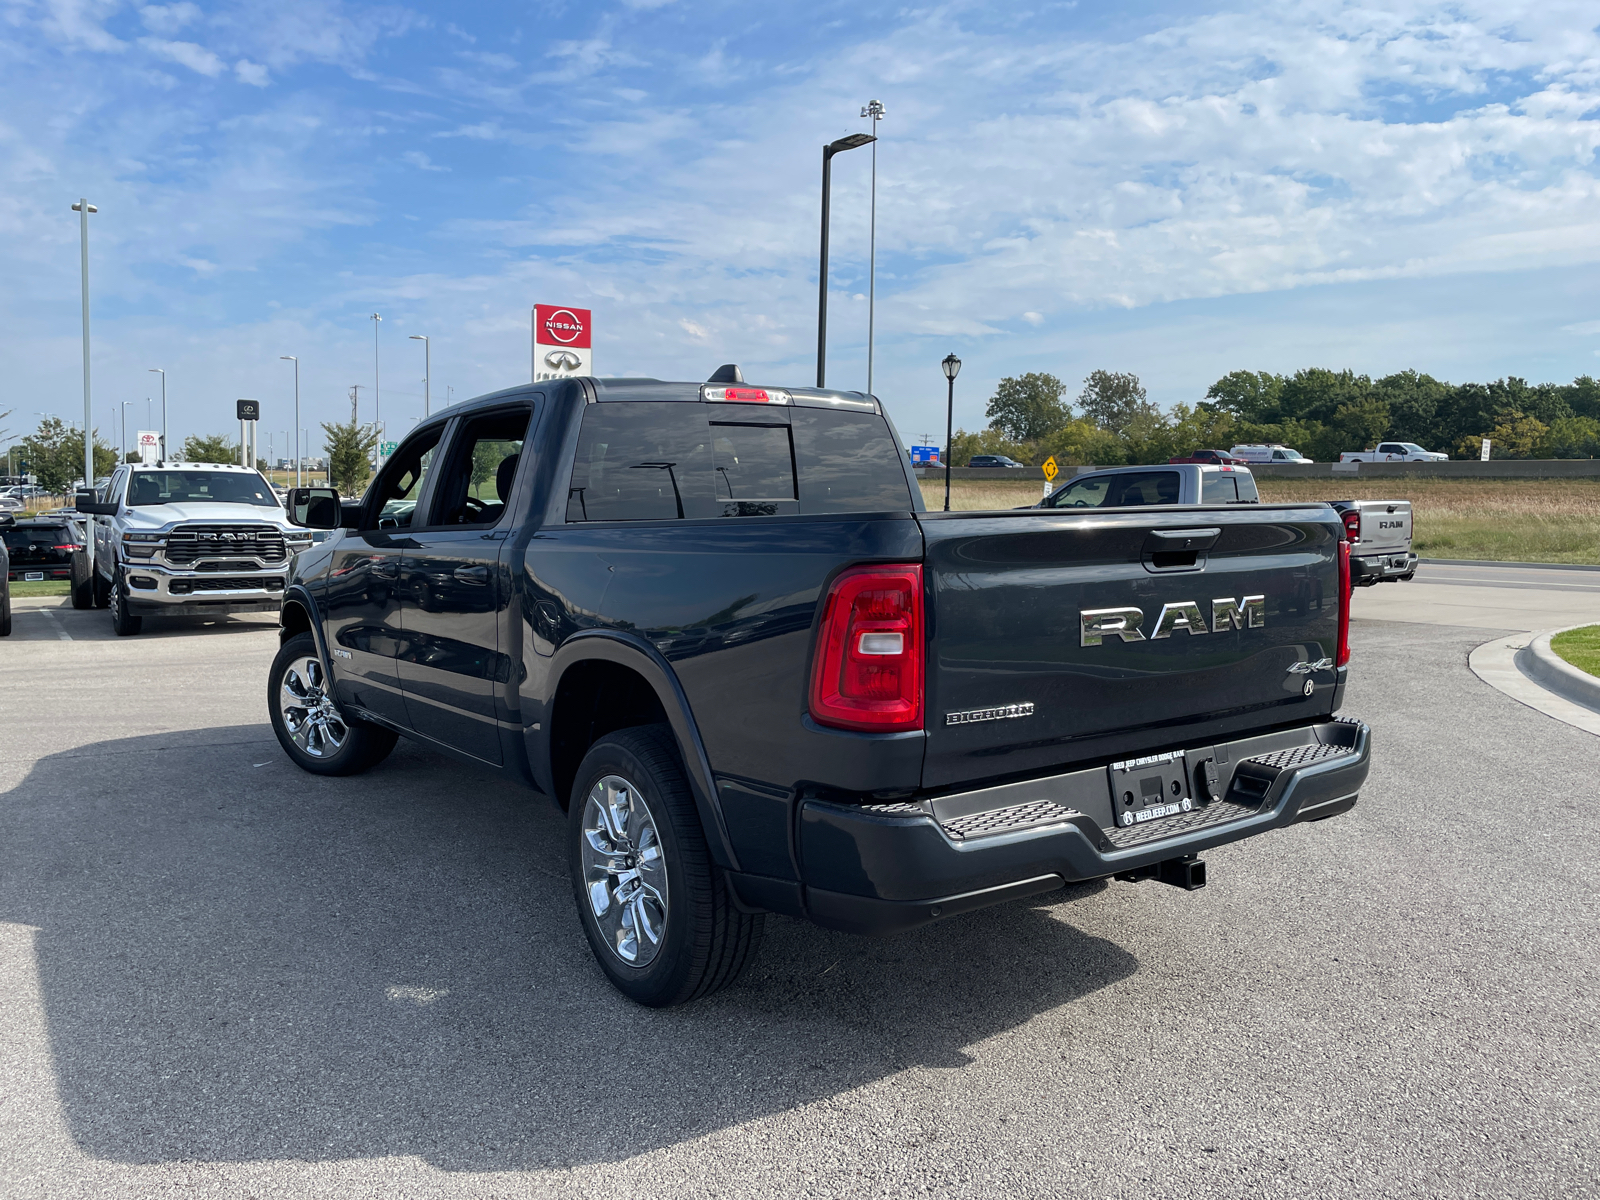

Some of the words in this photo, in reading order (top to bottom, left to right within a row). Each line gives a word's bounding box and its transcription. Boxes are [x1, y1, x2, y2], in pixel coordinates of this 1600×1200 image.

[546, 321, 583, 331] NISSAN
[1379, 520, 1403, 529] RAM
[199, 532, 256, 541] RAM
[1080, 595, 1265, 647] RAM
[946, 702, 1034, 725] BIGHORN
[1114, 762, 1124, 770] REED
[1126, 760, 1136, 768] JEEP
[1136, 755, 1158, 766] CHRYSLER
[1158, 752, 1172, 761] DODGE
[1174, 750, 1184, 758] RAM
[1136, 804, 1180, 822] REEDJEEP.COM
